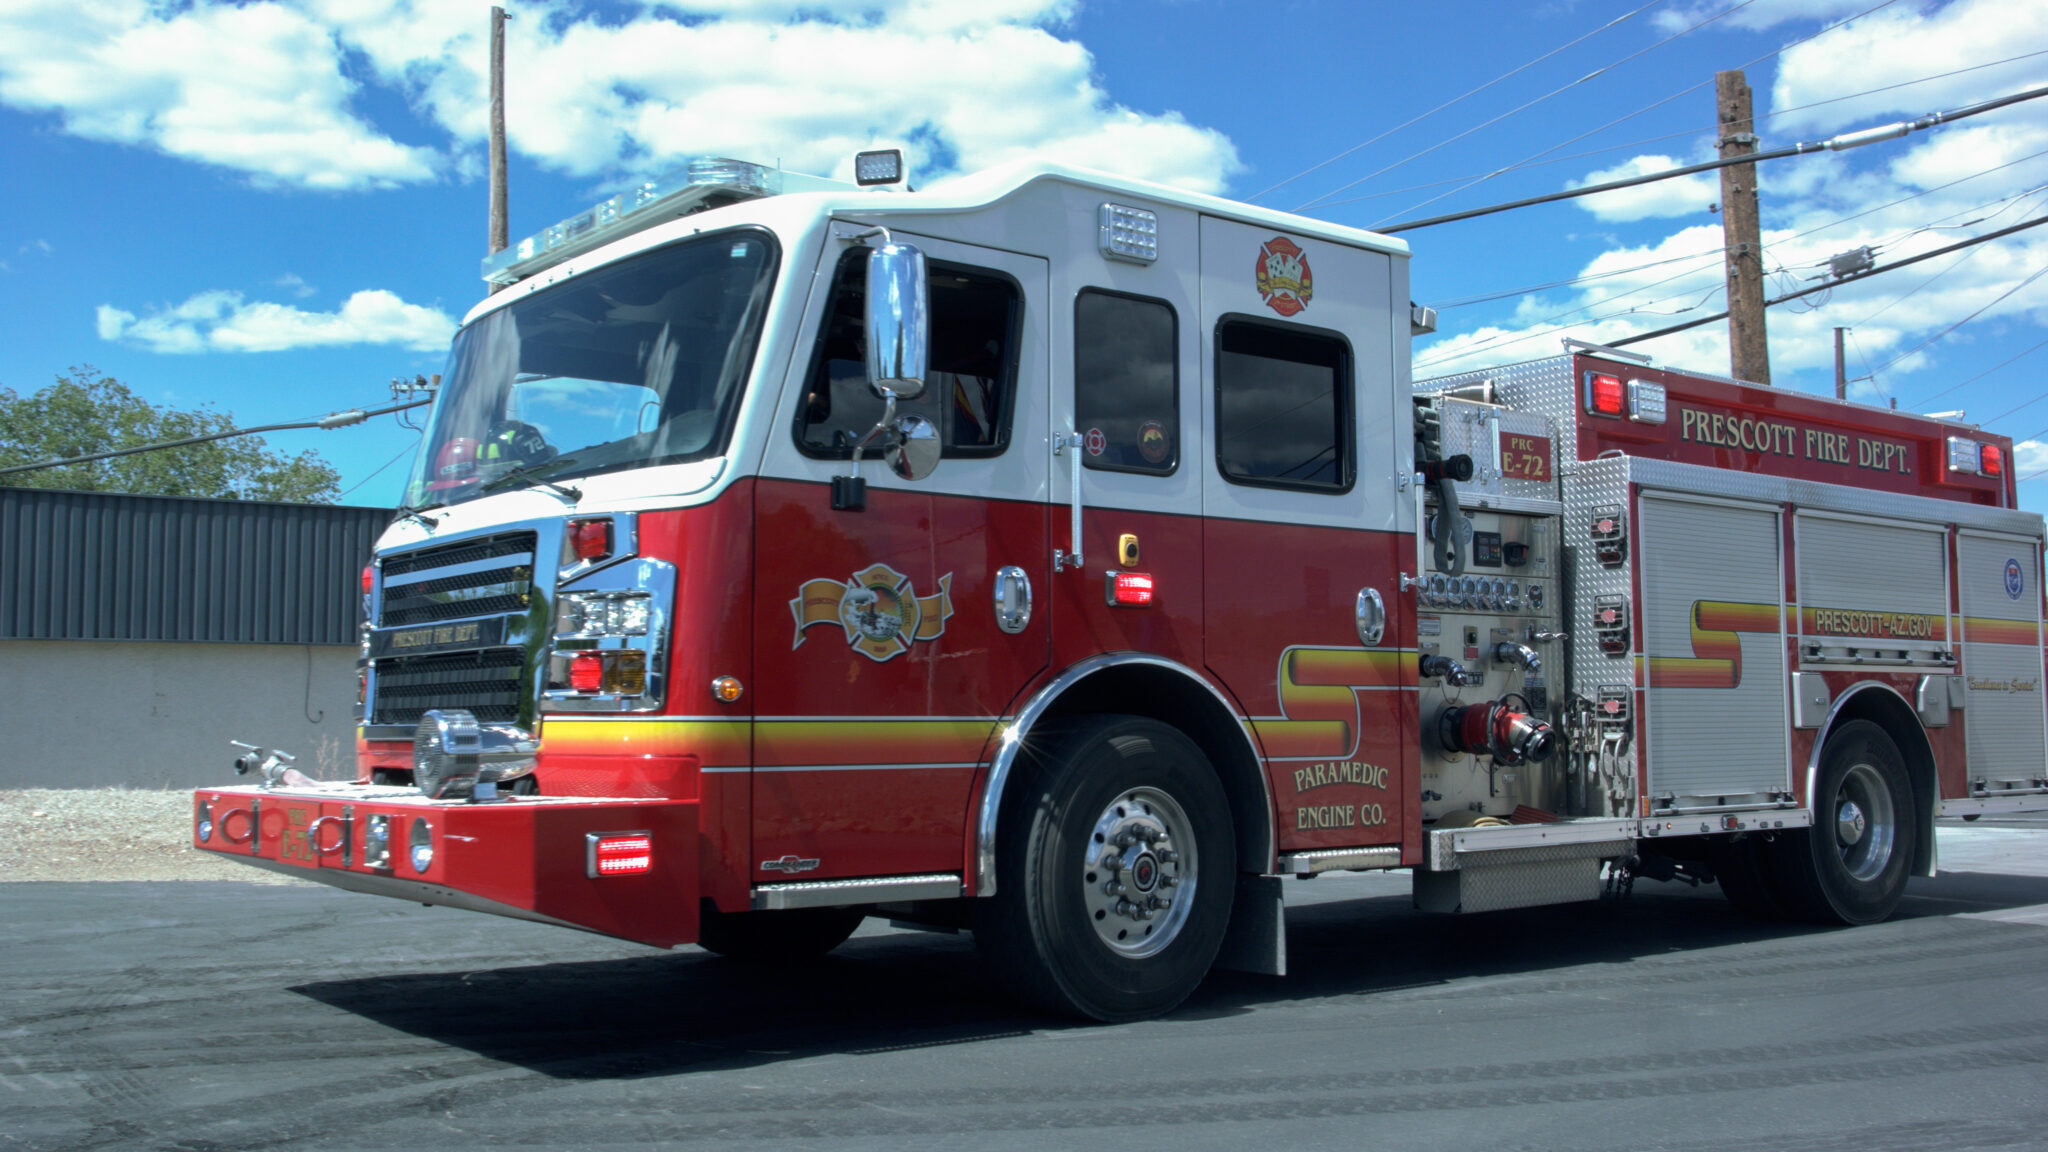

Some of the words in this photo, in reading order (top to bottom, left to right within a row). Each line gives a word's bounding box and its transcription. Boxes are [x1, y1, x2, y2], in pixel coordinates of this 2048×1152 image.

[524, 437, 545, 454] 72
[1511, 437, 1534, 452] PRC
[1682, 408, 1796, 456] PRESCOTT
[1804, 428, 1850, 465] FIRE
[1857, 437, 1912, 475] DEPT.
[1502, 451, 1544, 476] E-72
[1815, 609, 1933, 638] PRESCOTT-AZ.GOV
[1294, 761, 1389, 793] PARAMEDIC
[1296, 804, 1356, 830] ENGINE
[1361, 803, 1387, 826] CO.
